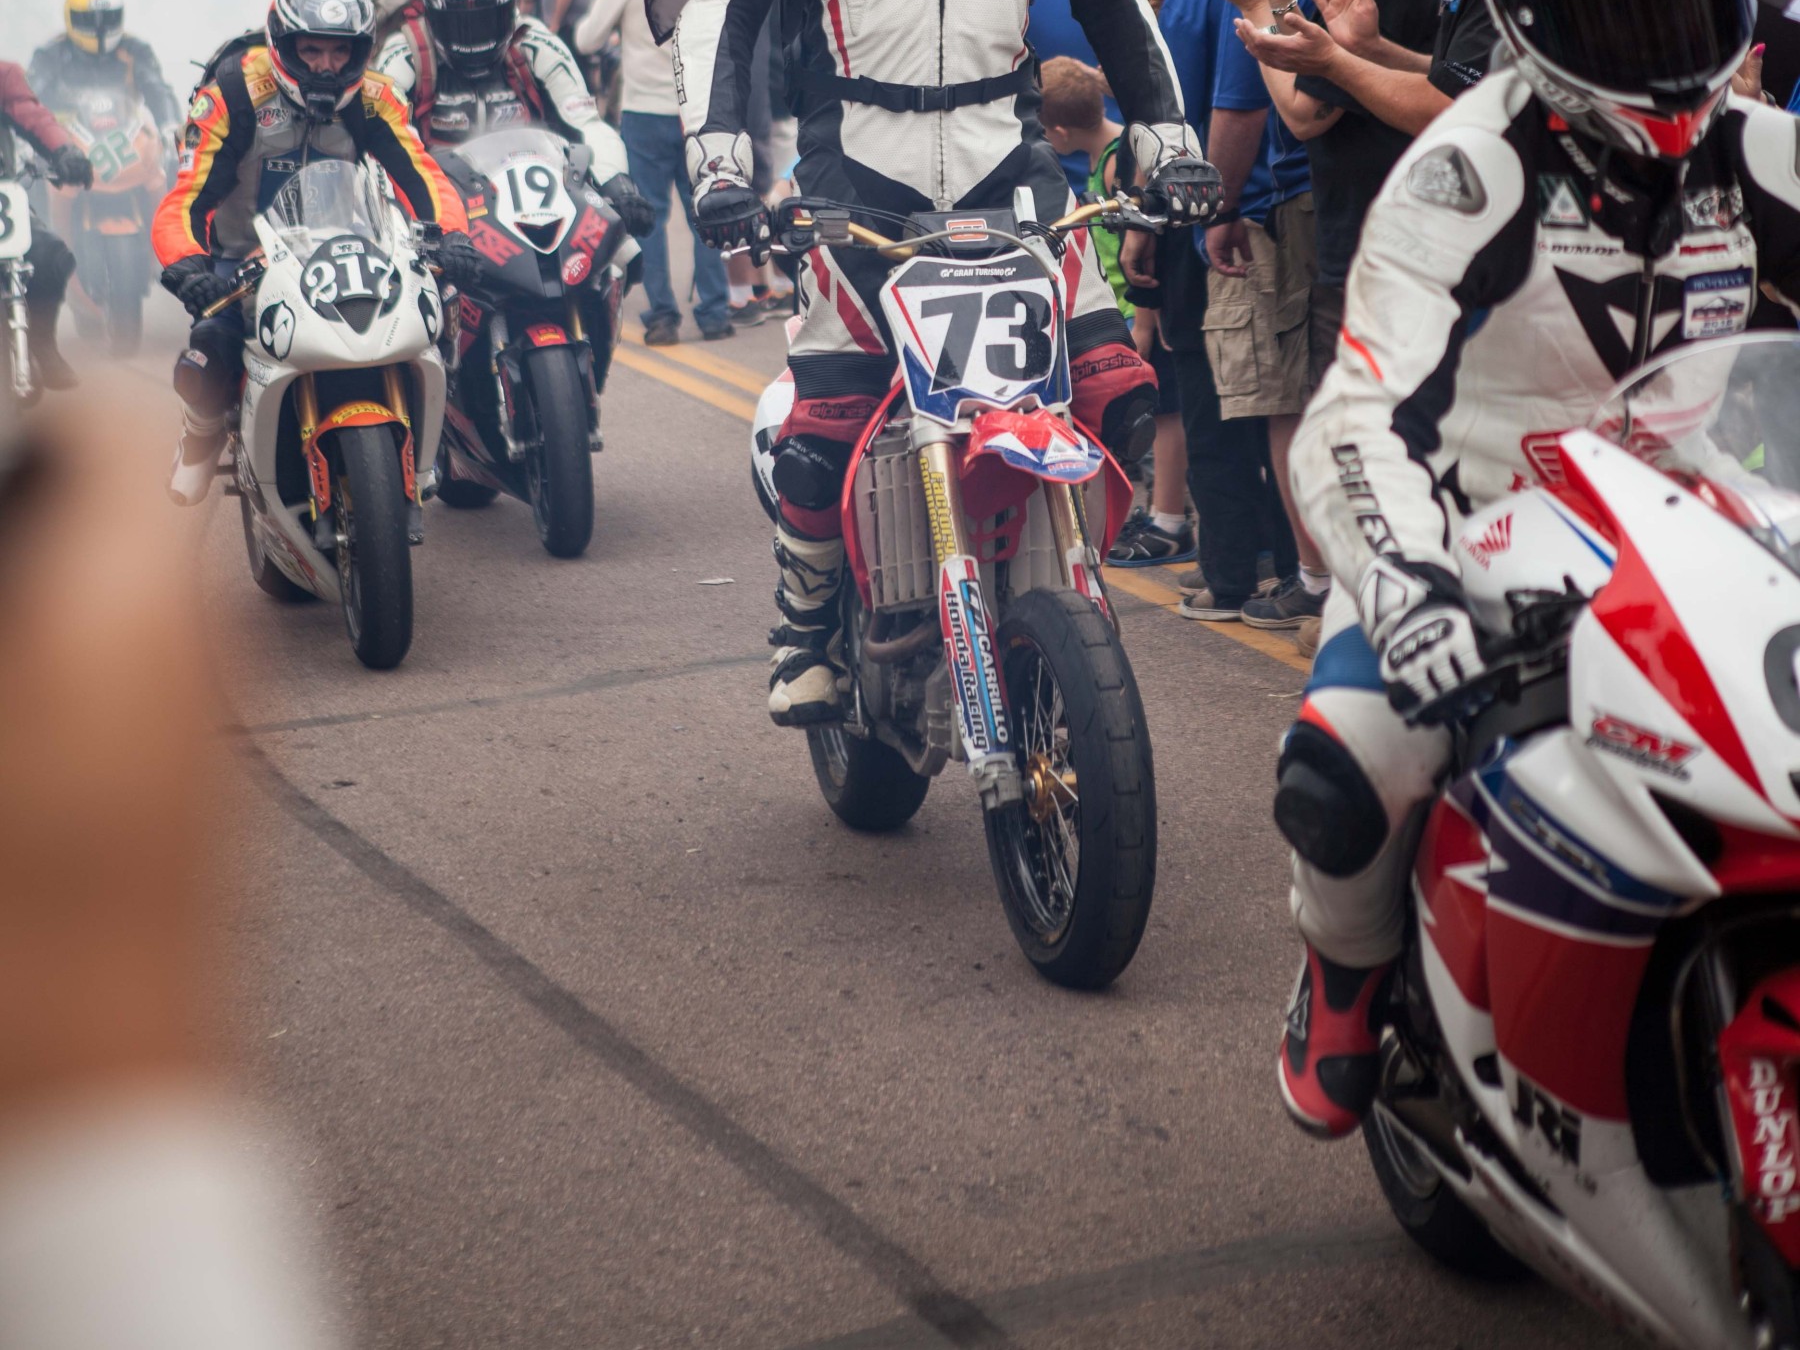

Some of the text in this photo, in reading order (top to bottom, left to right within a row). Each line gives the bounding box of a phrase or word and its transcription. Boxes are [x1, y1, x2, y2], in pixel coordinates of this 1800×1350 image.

[1468, 67, 1482, 79] FX
[88, 130, 141, 183] 92
[506, 165, 558, 213] 19
[954, 268, 973, 276] GRAN
[975, 268, 1004, 276] TURISMO
[1552, 244, 1619, 257] DUNLOP
[305, 254, 395, 307] 217
[921, 290, 1052, 393] 73
[946, 591, 988, 751] Honda Racing
[978, 634, 1008, 744] CARRILLO
[1751, 1057, 1800, 1223] DUNLOP
